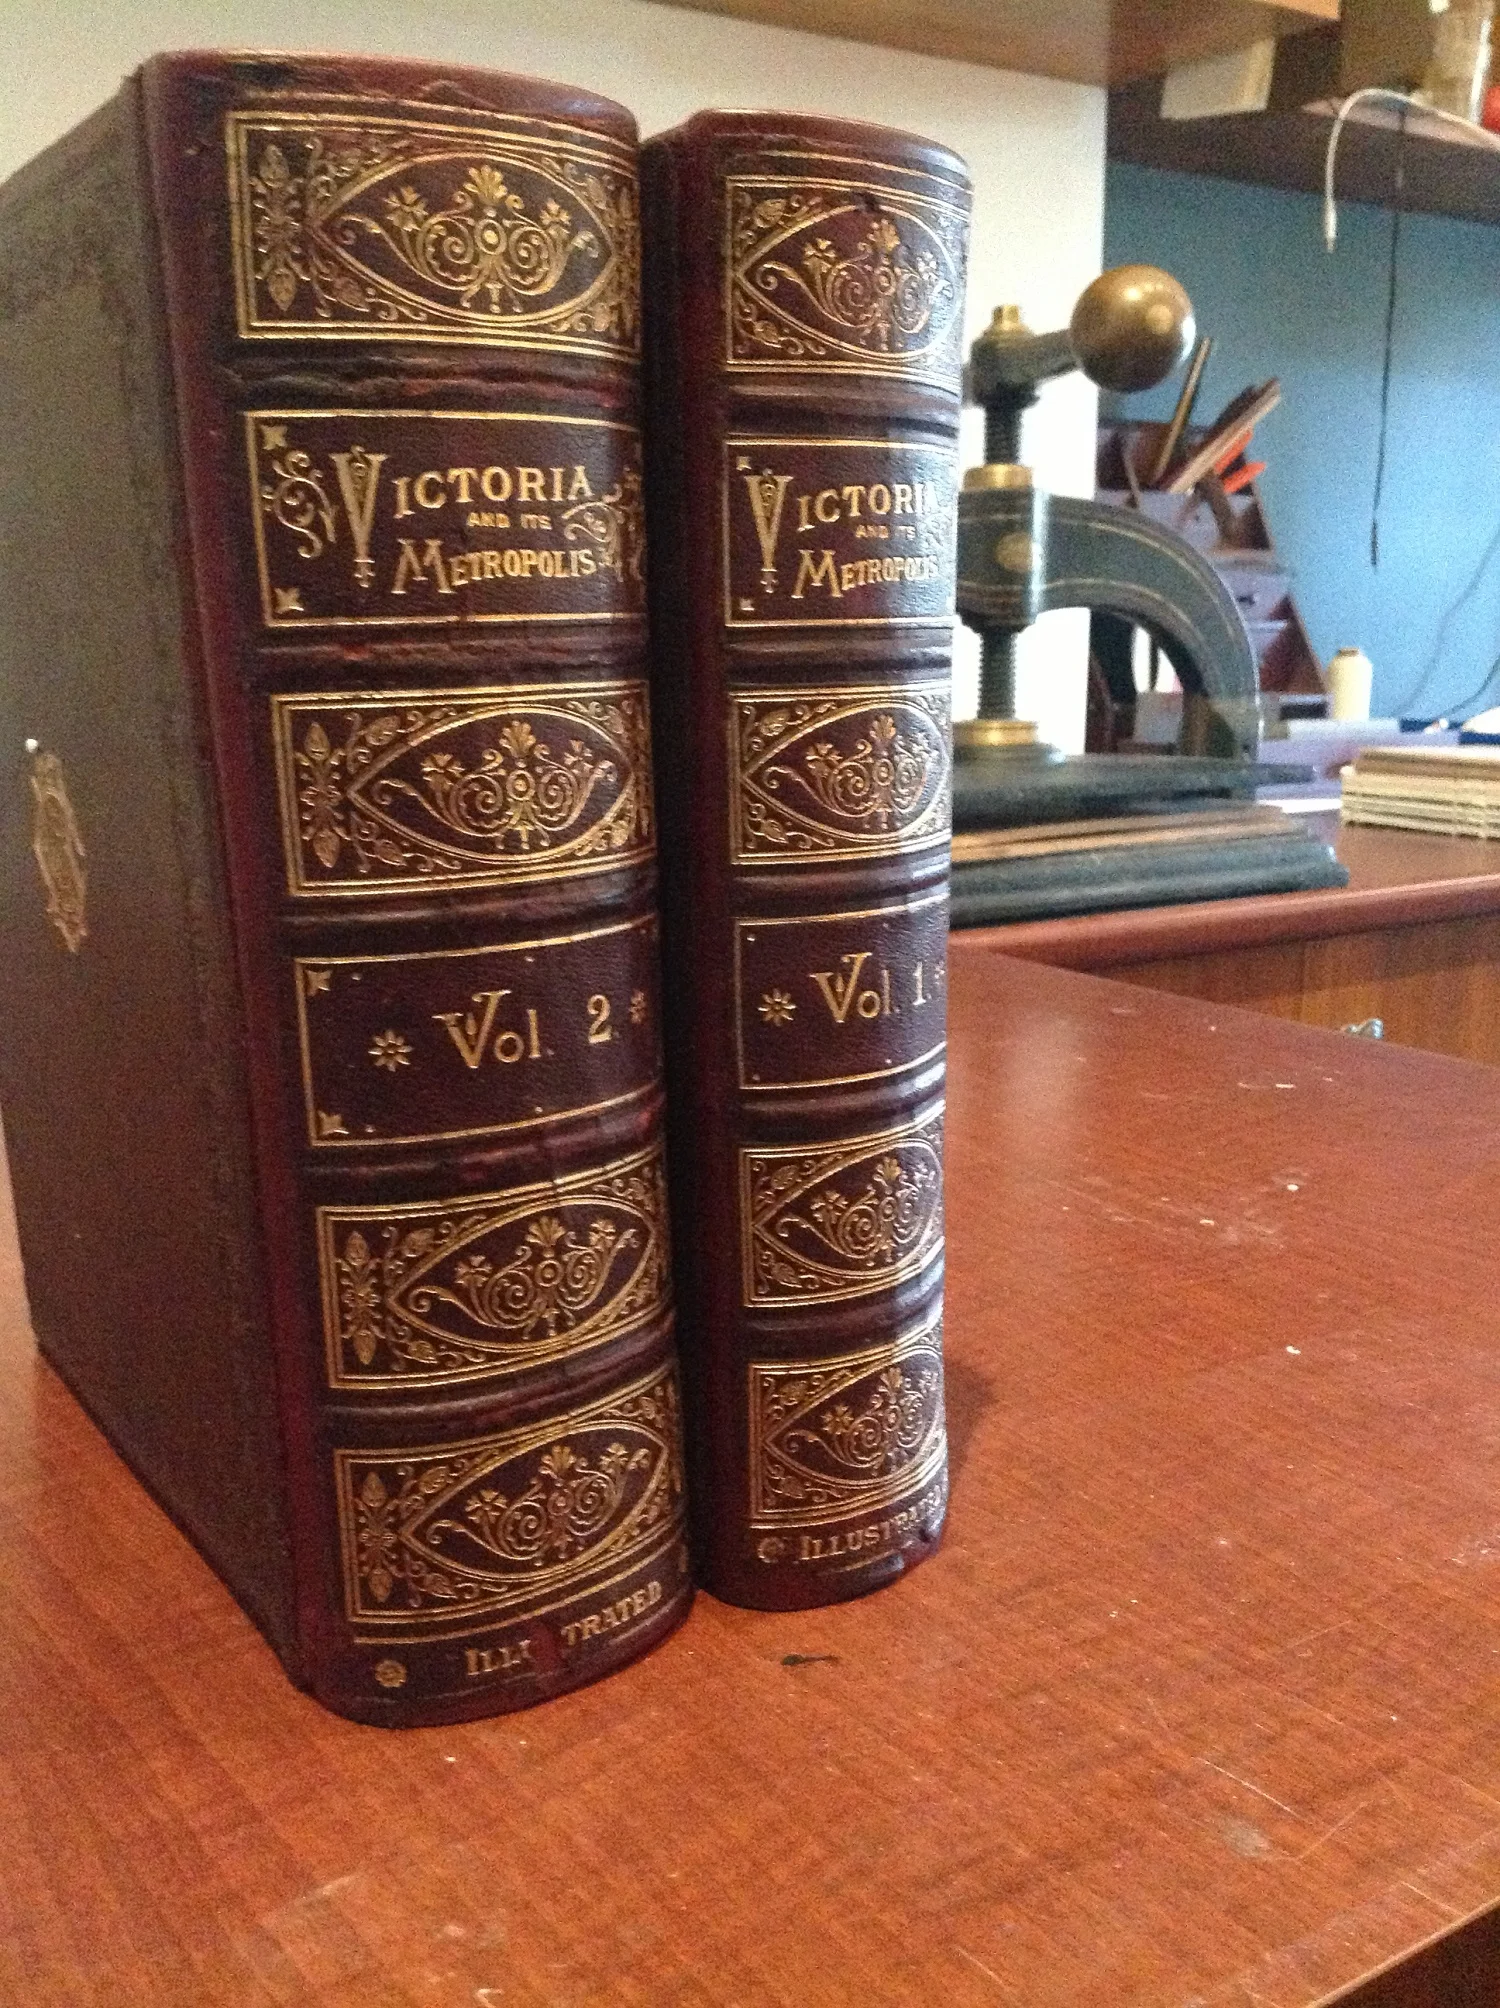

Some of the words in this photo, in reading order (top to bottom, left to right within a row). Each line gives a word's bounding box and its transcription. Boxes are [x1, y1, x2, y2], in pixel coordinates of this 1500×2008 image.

[329, 448, 595, 588] VICTORIA
[466, 512, 511, 528] AND
[520, 513, 552, 530] ITS
[744, 471, 940, 594] VICTORIA
[855, 524, 890, 539] AND
[390, 538, 598, 595] METROPOLIS
[790, 549, 939, 599] METROPOLIS
